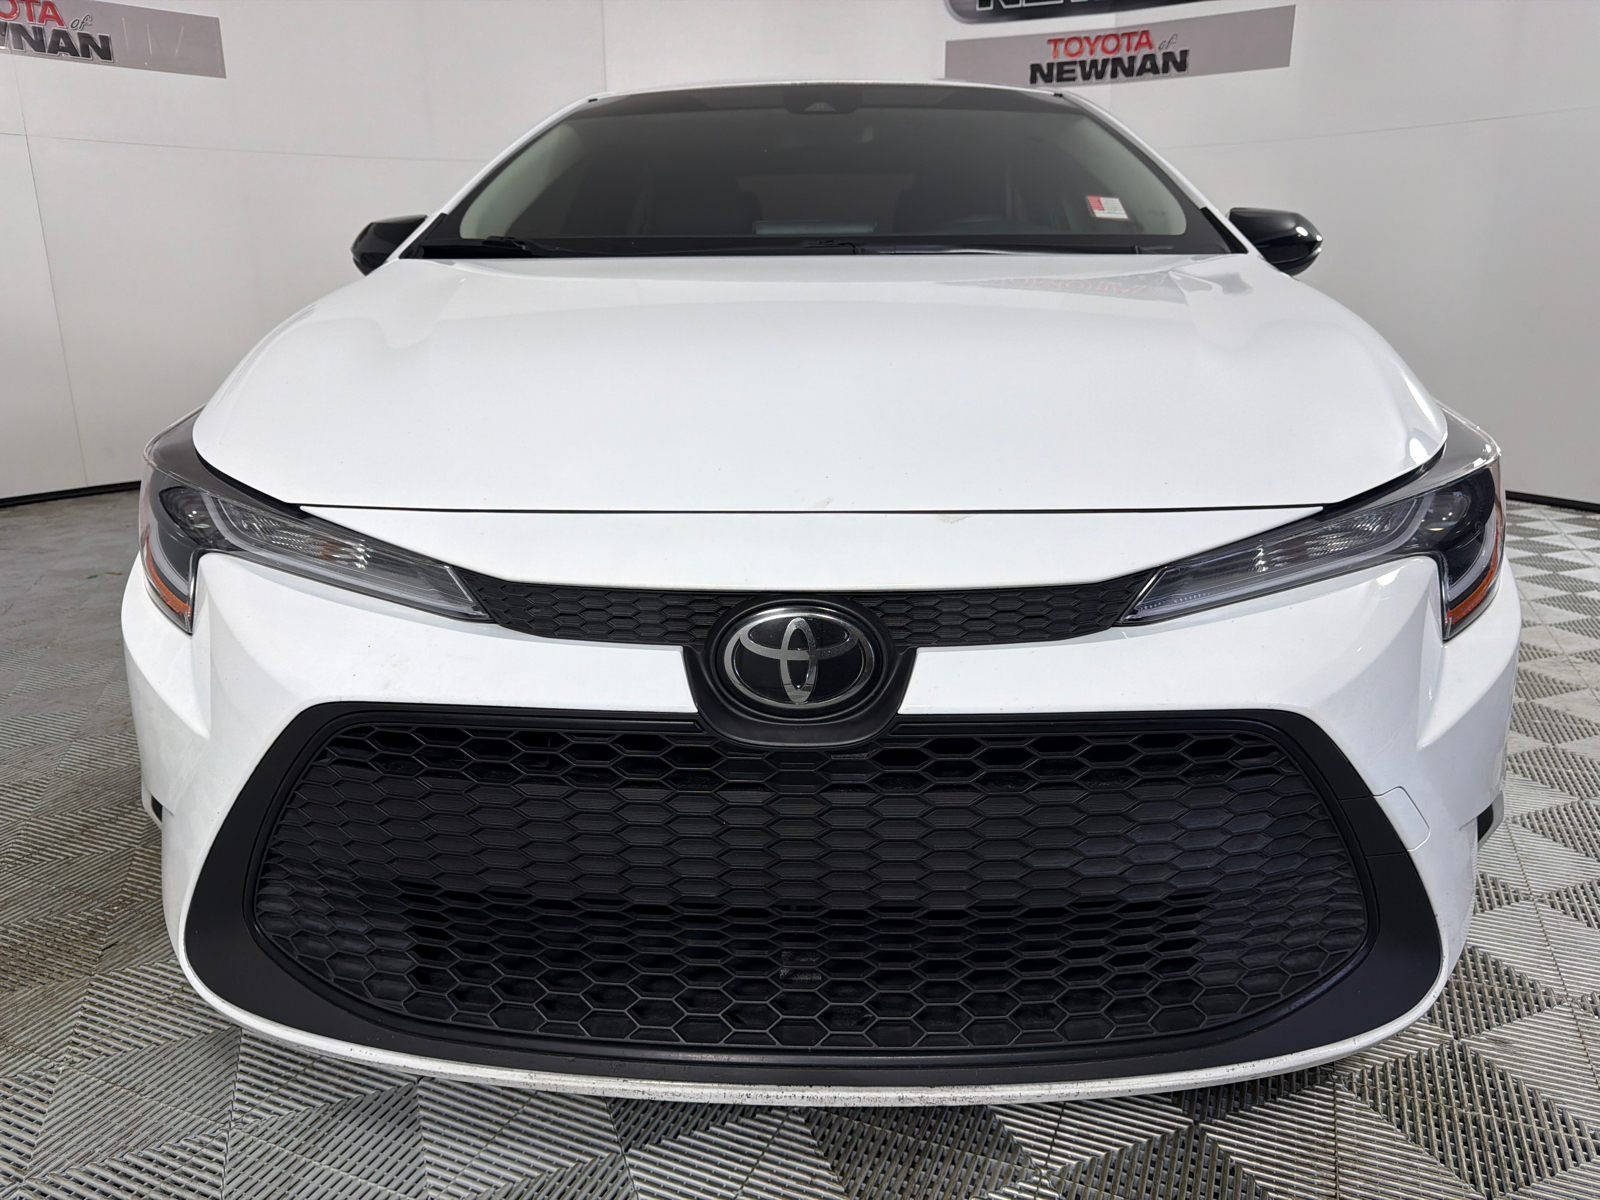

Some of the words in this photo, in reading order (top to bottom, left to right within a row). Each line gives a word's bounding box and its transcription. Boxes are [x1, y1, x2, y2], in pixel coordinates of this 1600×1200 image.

[70, 14, 93, 31] of
[1047, 29, 1155, 59] TOYOTA
[1158, 33, 1178, 51] of
[1029, 49, 1190, 85] NEWNAN
